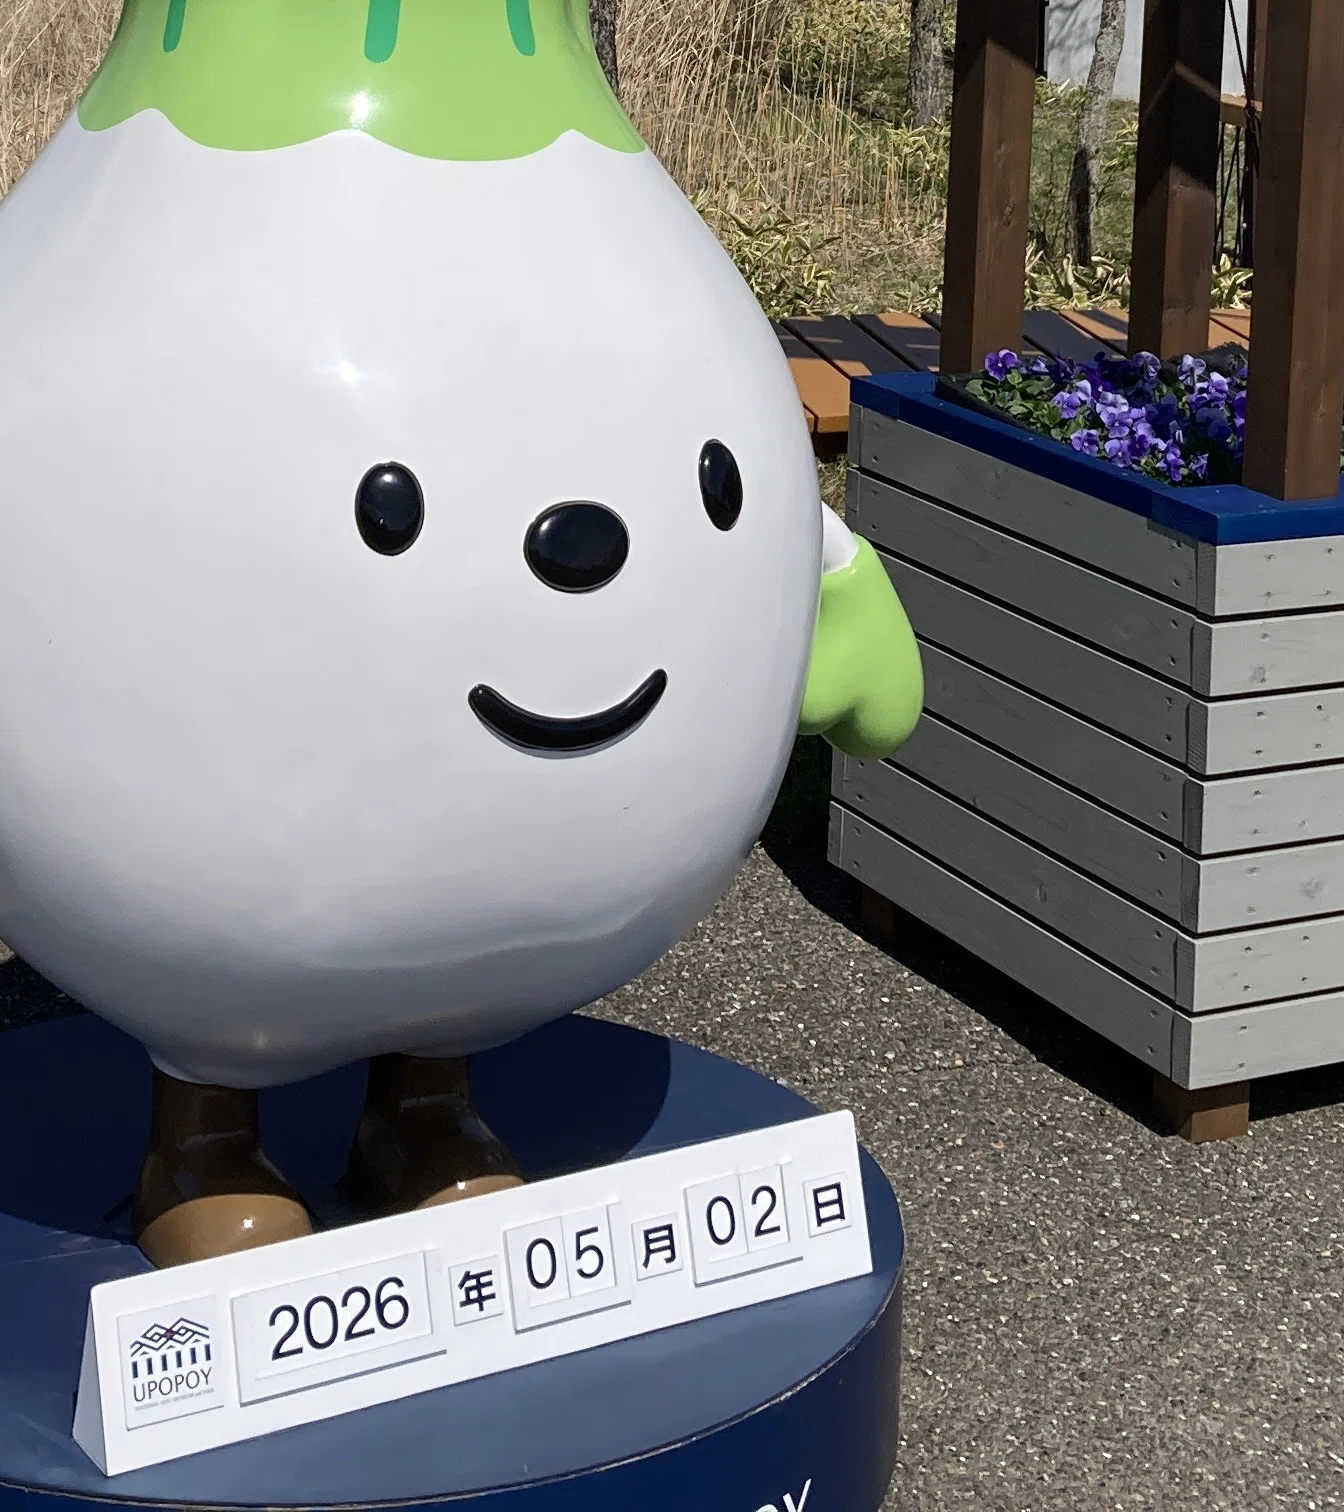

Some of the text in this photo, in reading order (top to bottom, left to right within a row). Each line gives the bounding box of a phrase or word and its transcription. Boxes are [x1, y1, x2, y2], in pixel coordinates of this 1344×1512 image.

[267, 1180, 847, 1361] 2026 年 05 月 02 日
[132, 1366, 213, 1403] UPOPOY
